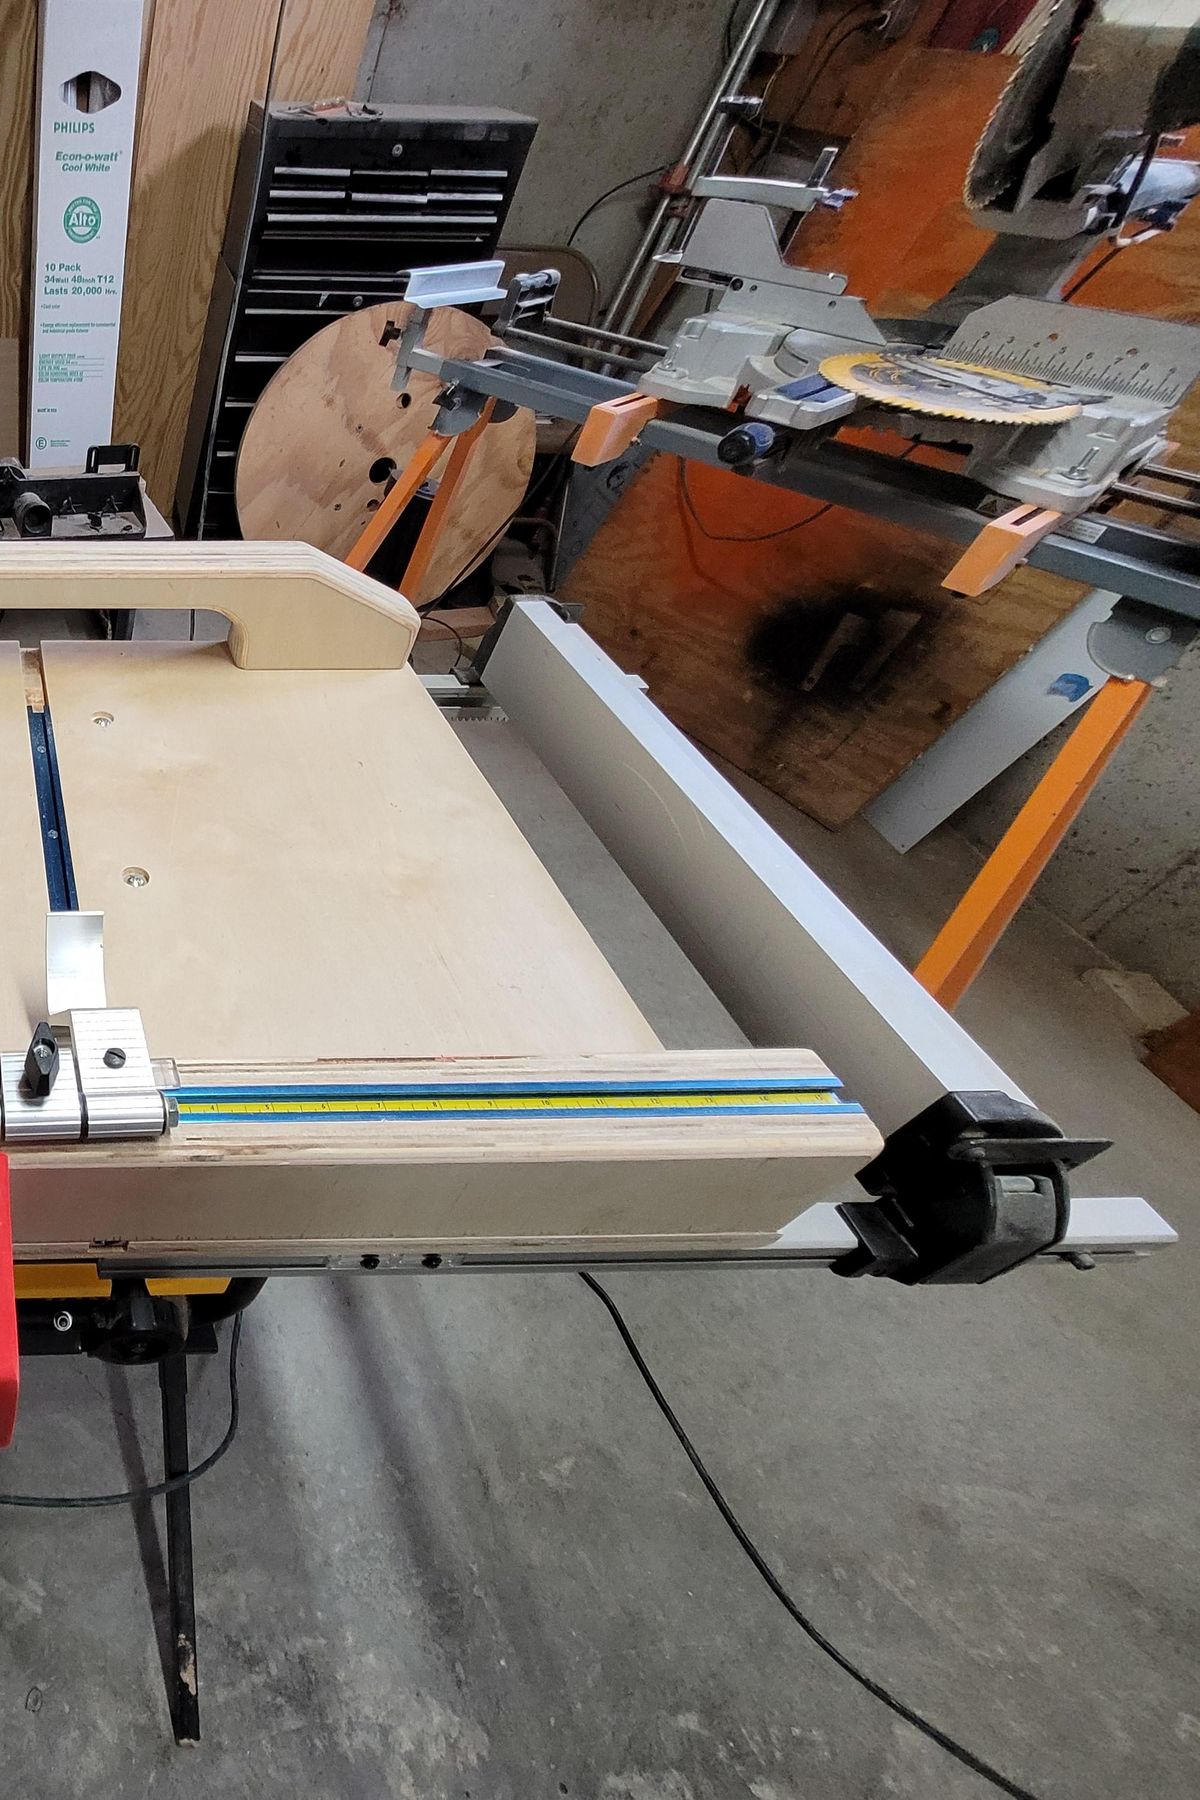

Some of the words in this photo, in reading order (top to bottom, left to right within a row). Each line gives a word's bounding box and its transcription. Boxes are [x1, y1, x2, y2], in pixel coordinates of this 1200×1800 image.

[54, 122, 95, 134] PHILIPS
[62, 163, 82, 172] Cool
[85, 163, 110, 172] White
[68, 212, 96, 226] Alto
[59, 263, 81, 271] Pack
[97, 275, 114, 283] T12
[44, 287, 68, 295] Lasts
[72, 287, 102, 296] 20,000
[1059, 346, 1067, 354] 5
[1086, 352, 1094, 360] 6
[1140, 362, 1149, 371] 8
